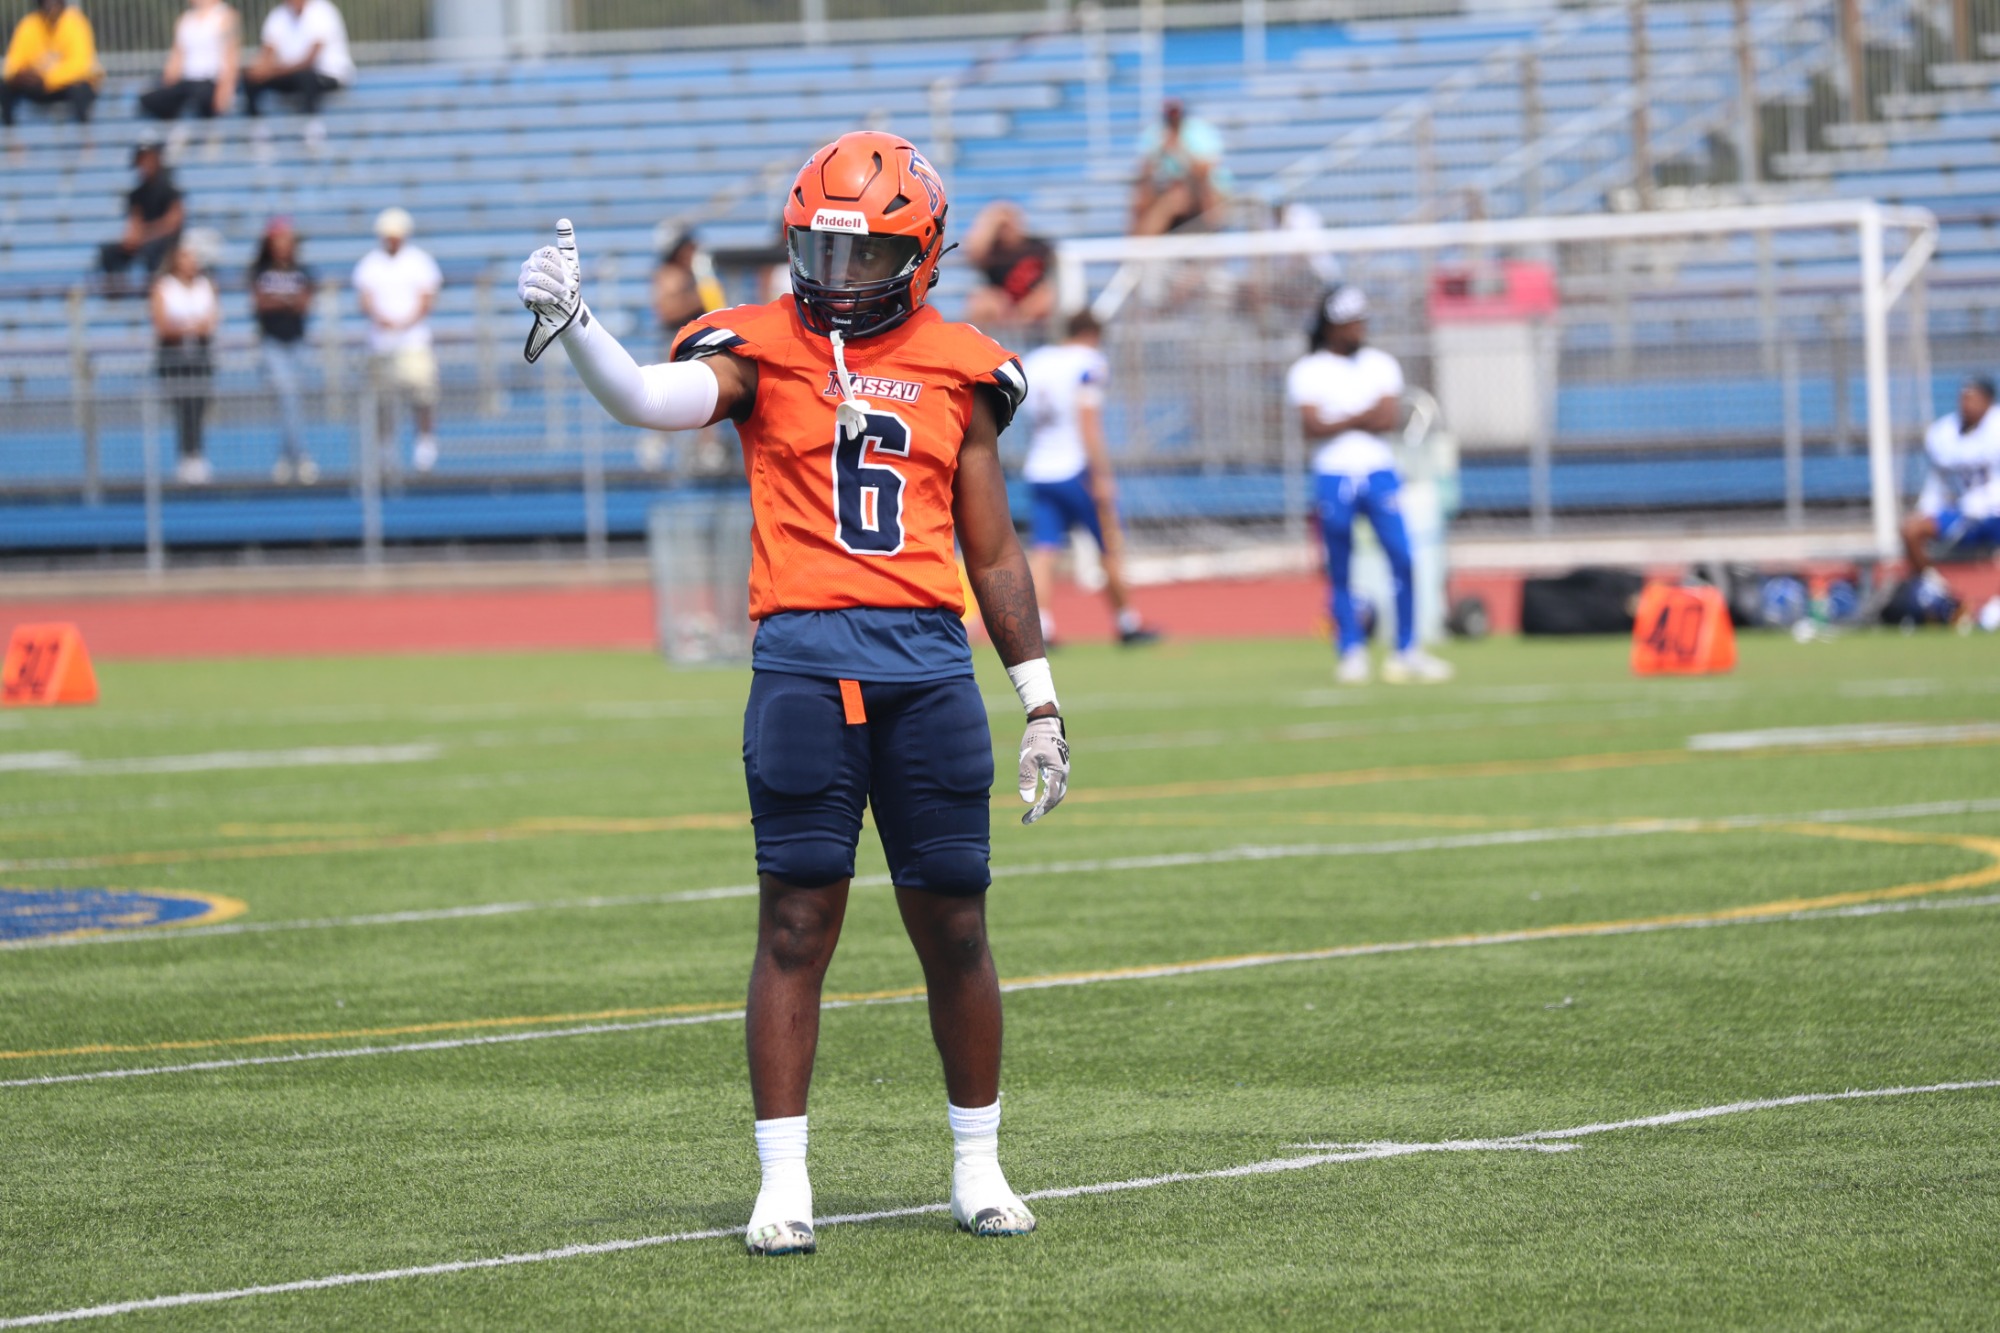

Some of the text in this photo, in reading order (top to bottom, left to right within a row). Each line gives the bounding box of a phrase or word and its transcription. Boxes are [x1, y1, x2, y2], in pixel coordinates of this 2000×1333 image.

[816, 215, 862, 228] Riddell
[831, 408, 911, 556] 6
[1647, 603, 1704, 662] 40
